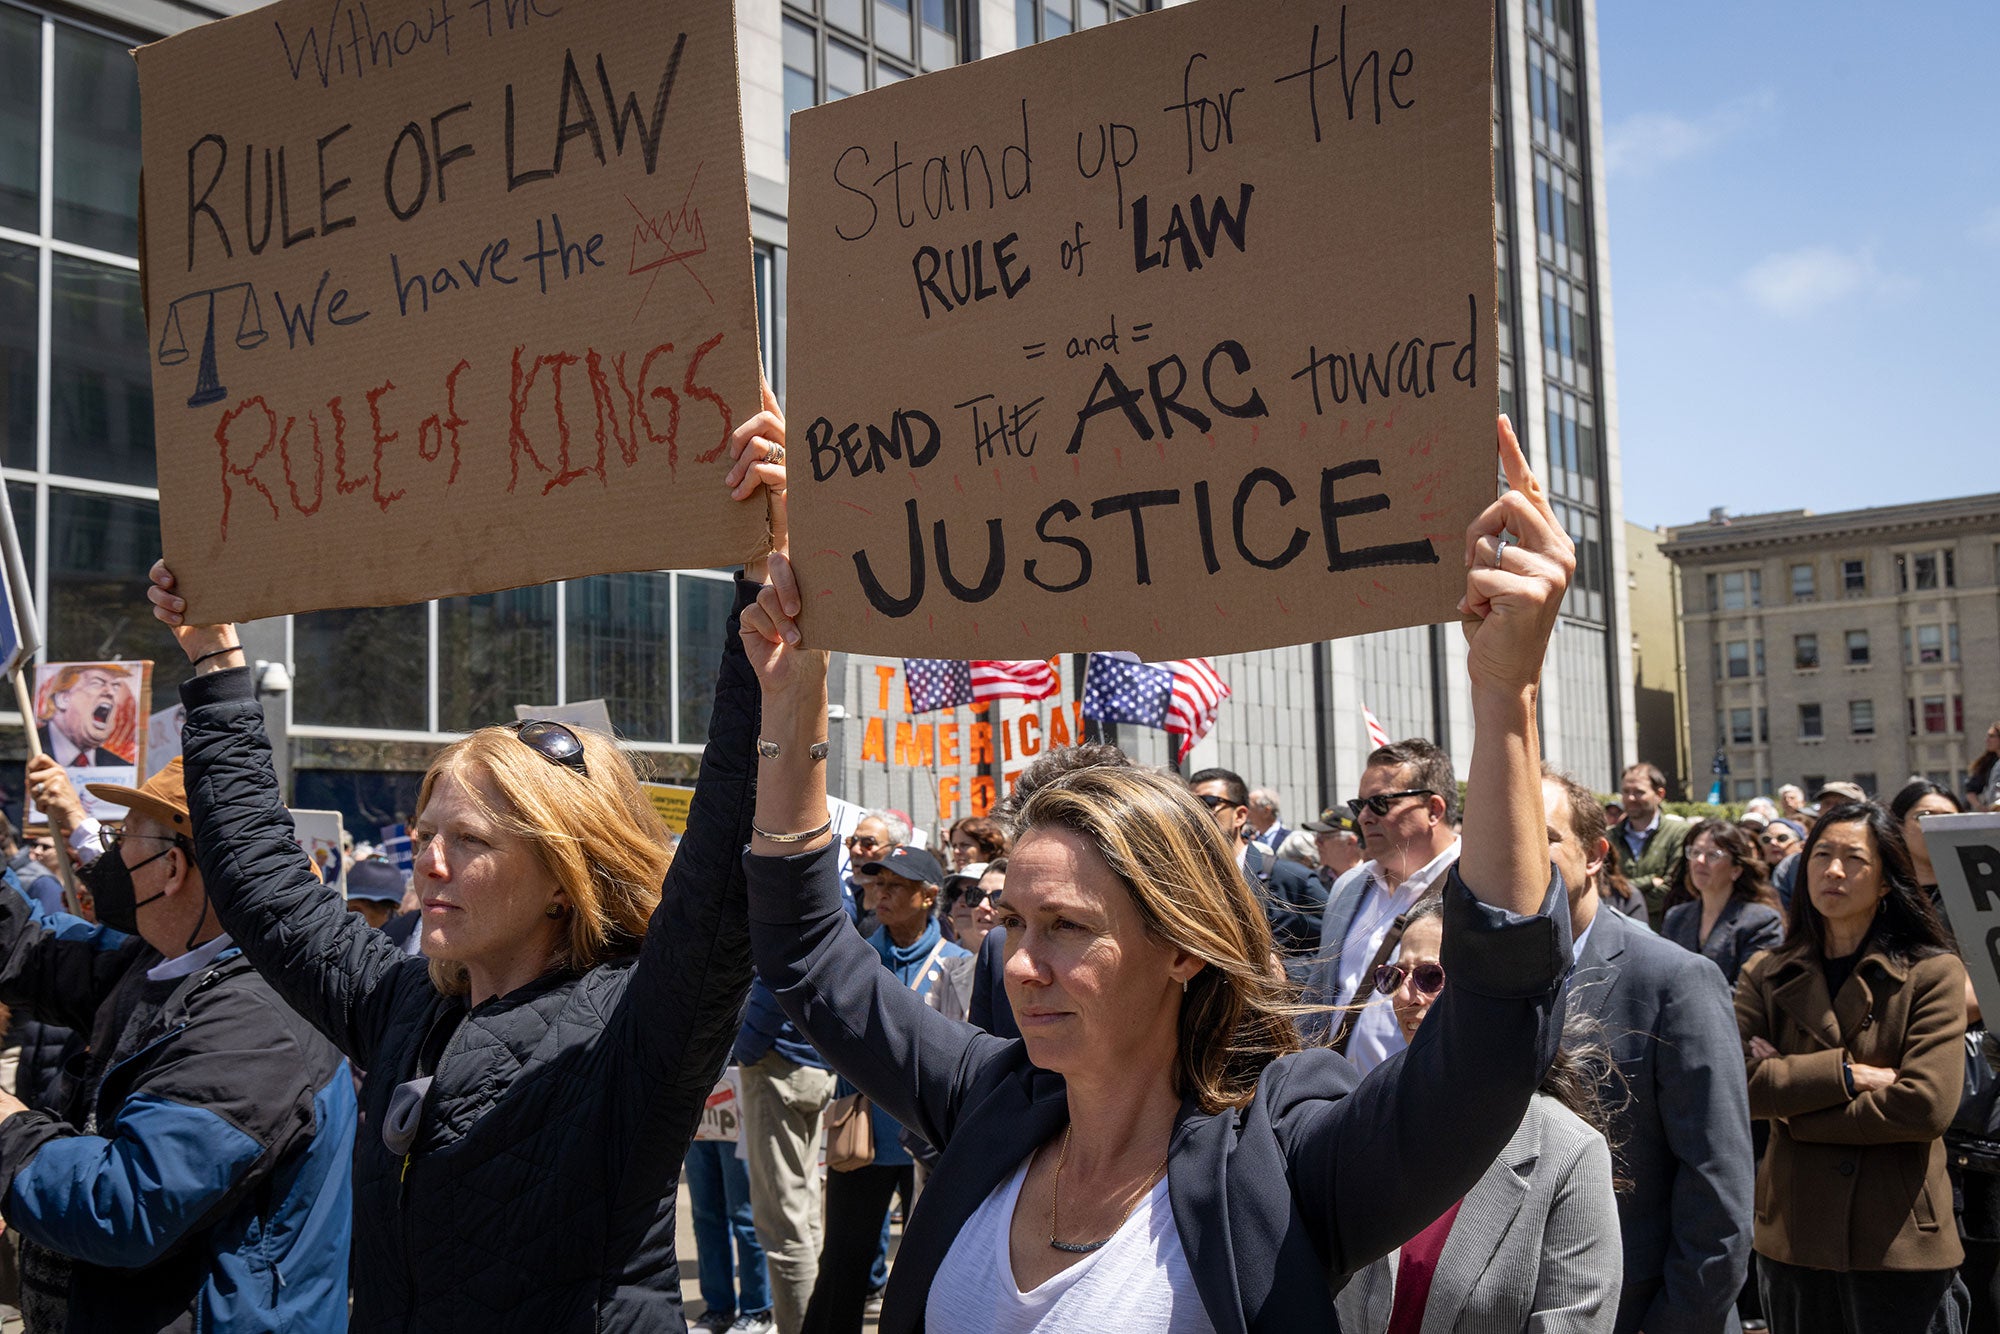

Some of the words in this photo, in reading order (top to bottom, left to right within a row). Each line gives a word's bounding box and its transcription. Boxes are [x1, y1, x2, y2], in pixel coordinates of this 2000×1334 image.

[275, 0, 455, 88] Without
[834, 99, 1033, 242] Stand
[1077, 121, 1139, 230] up
[1164, 53, 1246, 175] for
[1274, 4, 1416, 143] the
[187, 124, 357, 272] RULE
[384, 101, 476, 222] OF
[505, 32, 688, 194] LAW
[275, 269, 371, 349] We
[391, 237, 518, 317] have
[522, 213, 605, 295] the
[912, 231, 1032, 320] RULE
[1060, 221, 1091, 278] of
[1132, 183, 1255, 274] LAW
[805, 407, 942, 483] BEND
[955, 393, 1047, 467] THE
[1066, 340, 1270, 456] ARC
[1291, 293, 1478, 416] toward
[1065, 315, 1120, 361] and
[215, 379, 405, 542] RULE
[419, 358, 471, 487] of
[507, 332, 733, 496] KINGS
[853, 458, 1440, 619] JUSTICE
